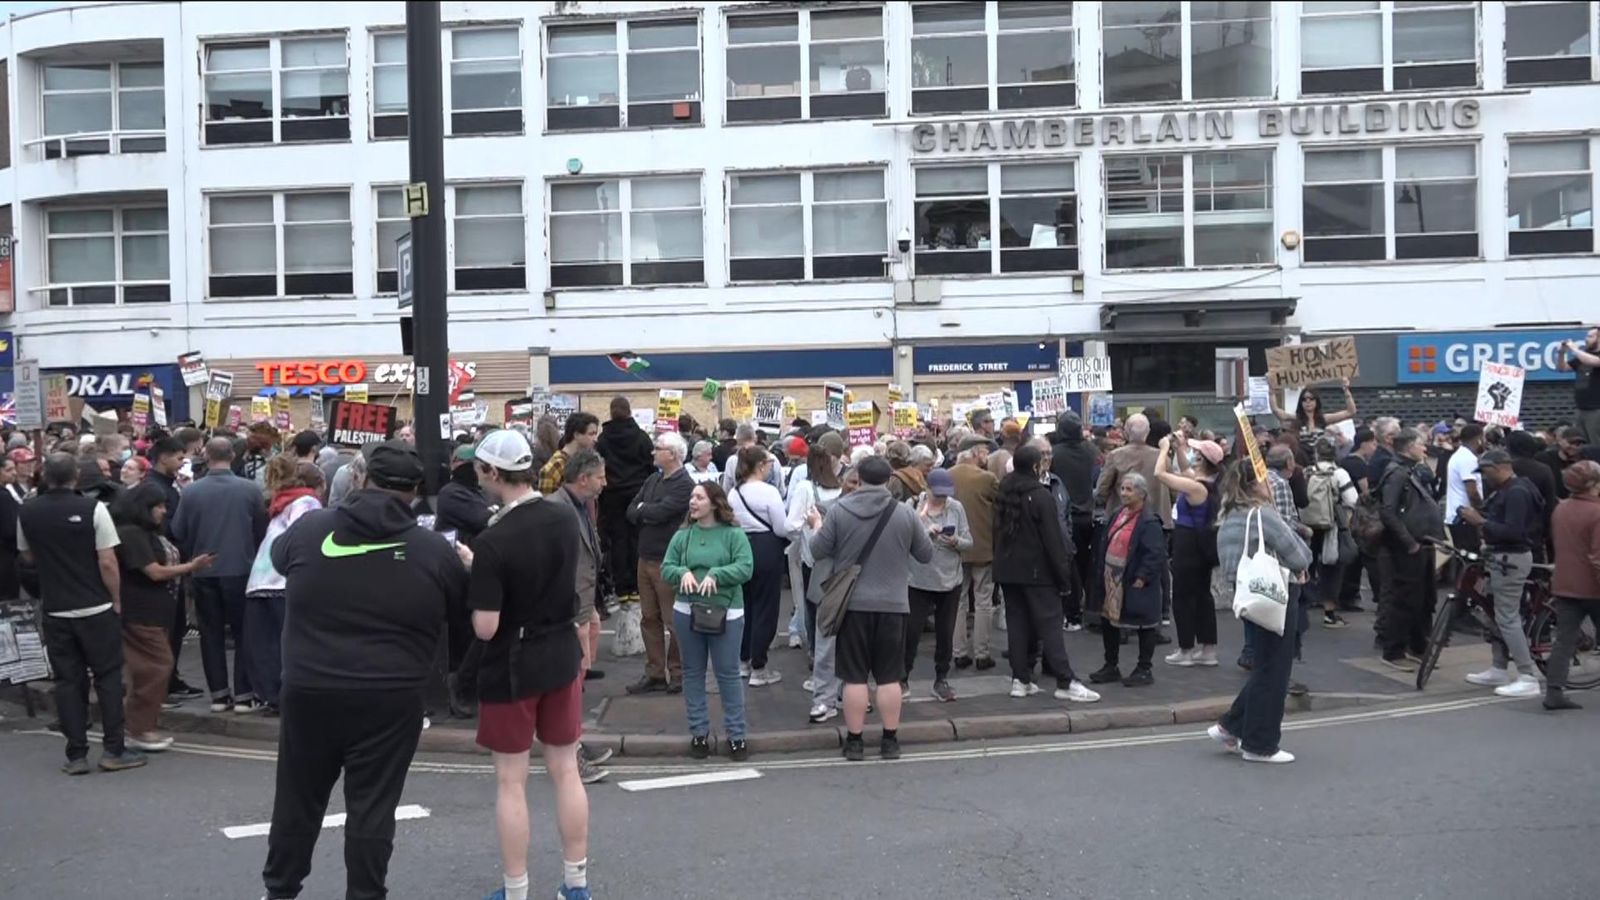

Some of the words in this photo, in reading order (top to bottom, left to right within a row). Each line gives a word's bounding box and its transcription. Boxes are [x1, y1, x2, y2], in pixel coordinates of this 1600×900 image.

[912, 112, 1233, 152] CHAMBERLAIN
[1258, 99, 1481, 138] BUILDING
[407, 187, 424, 214] H
[403, 253, 410, 289] P
[1093, 357, 1109, 372] OUT
[1290, 341, 1342, 365] HONK
[256, 360, 367, 385] TESCO
[928, 364, 973, 372] FREDERICK
[978, 363, 1009, 371] STREET
[1276, 363, 1357, 385] HUMANITY
[335, 402, 390, 433] FREE
[757, 407, 780, 420] NOW!
[333, 429, 387, 445] PALESTINE
